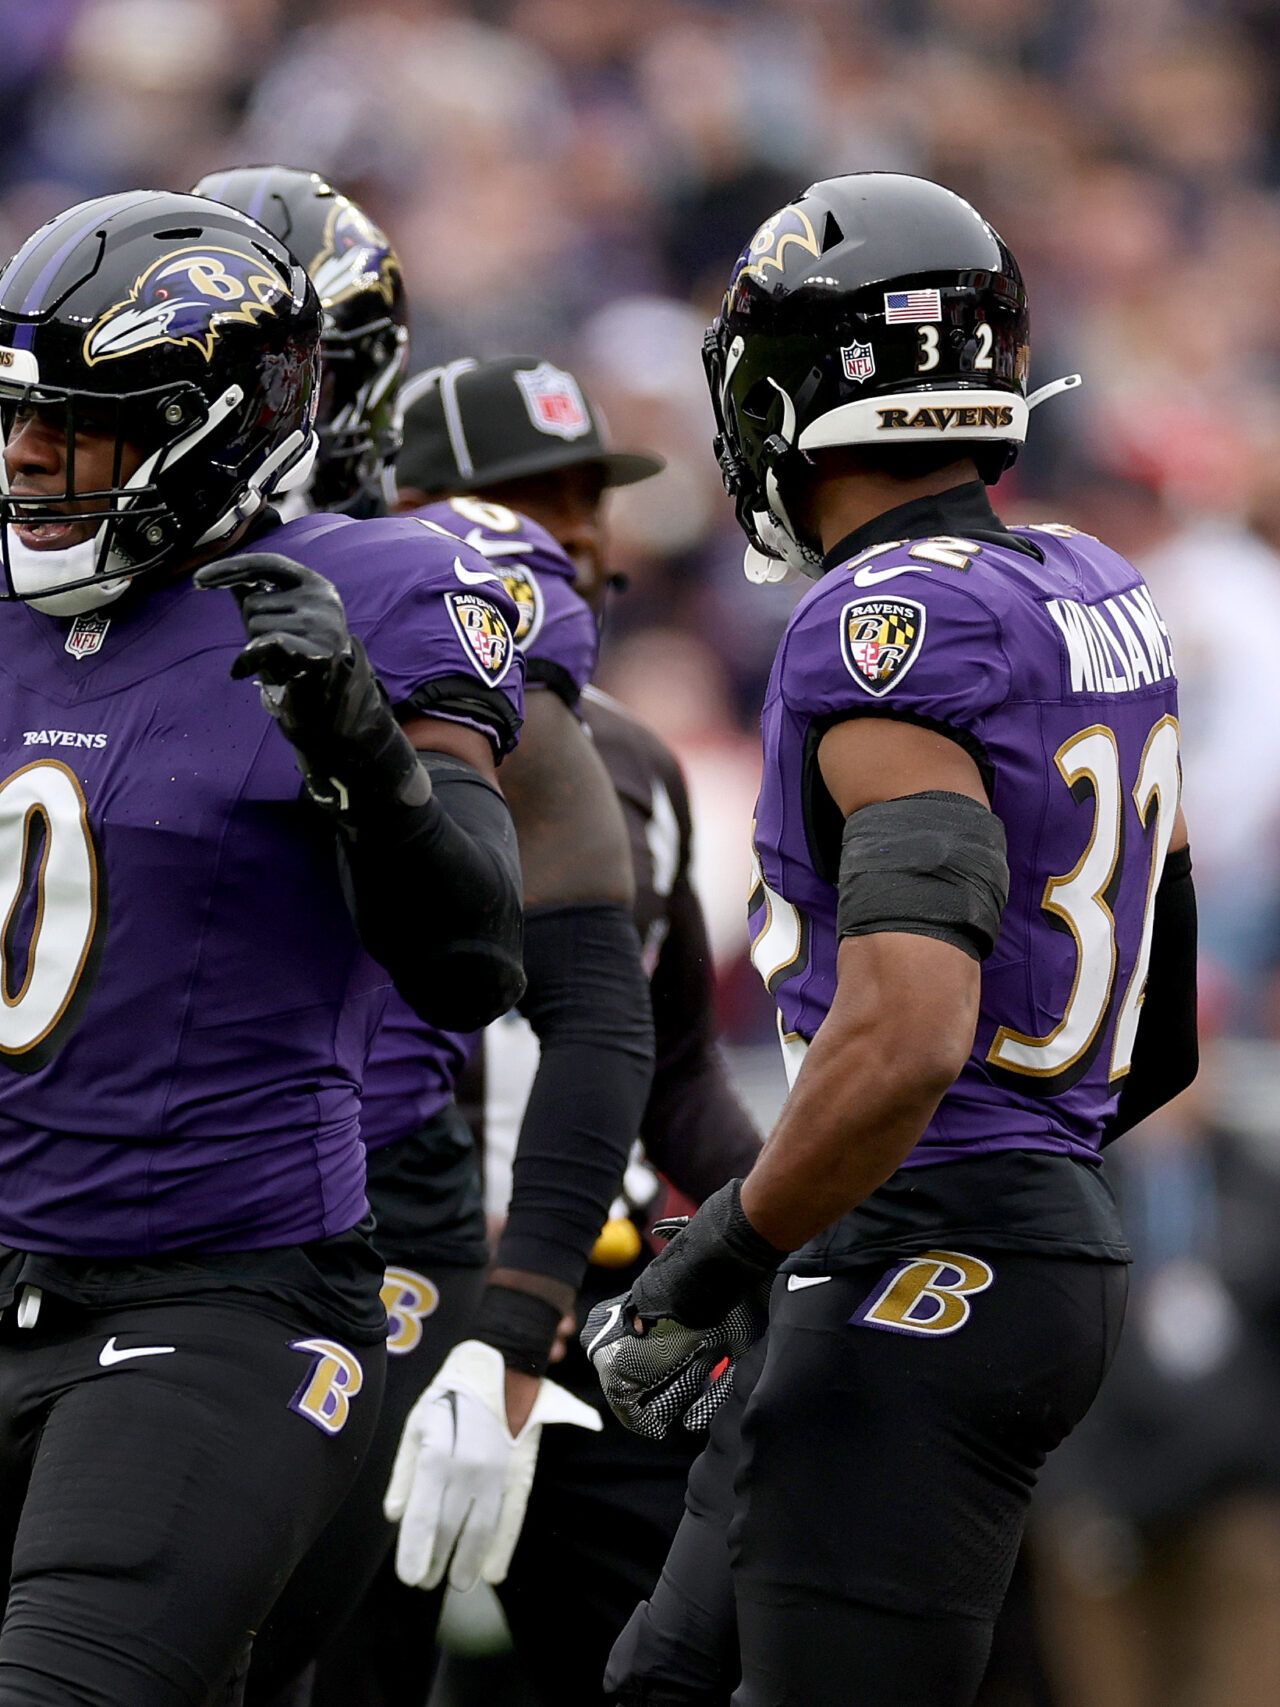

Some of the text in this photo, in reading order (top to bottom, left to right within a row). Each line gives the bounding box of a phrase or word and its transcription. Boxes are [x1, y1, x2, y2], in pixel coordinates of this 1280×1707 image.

[847, 358, 872, 377] NFL
[876, 405, 1014, 432] RAVENS
[851, 603, 915, 619] RAVENS
[72, 632, 98, 650] NFL
[23, 730, 108, 749] RAVENS
[863, 1250, 994, 1336] B
[292, 1338, 364, 1433] B
